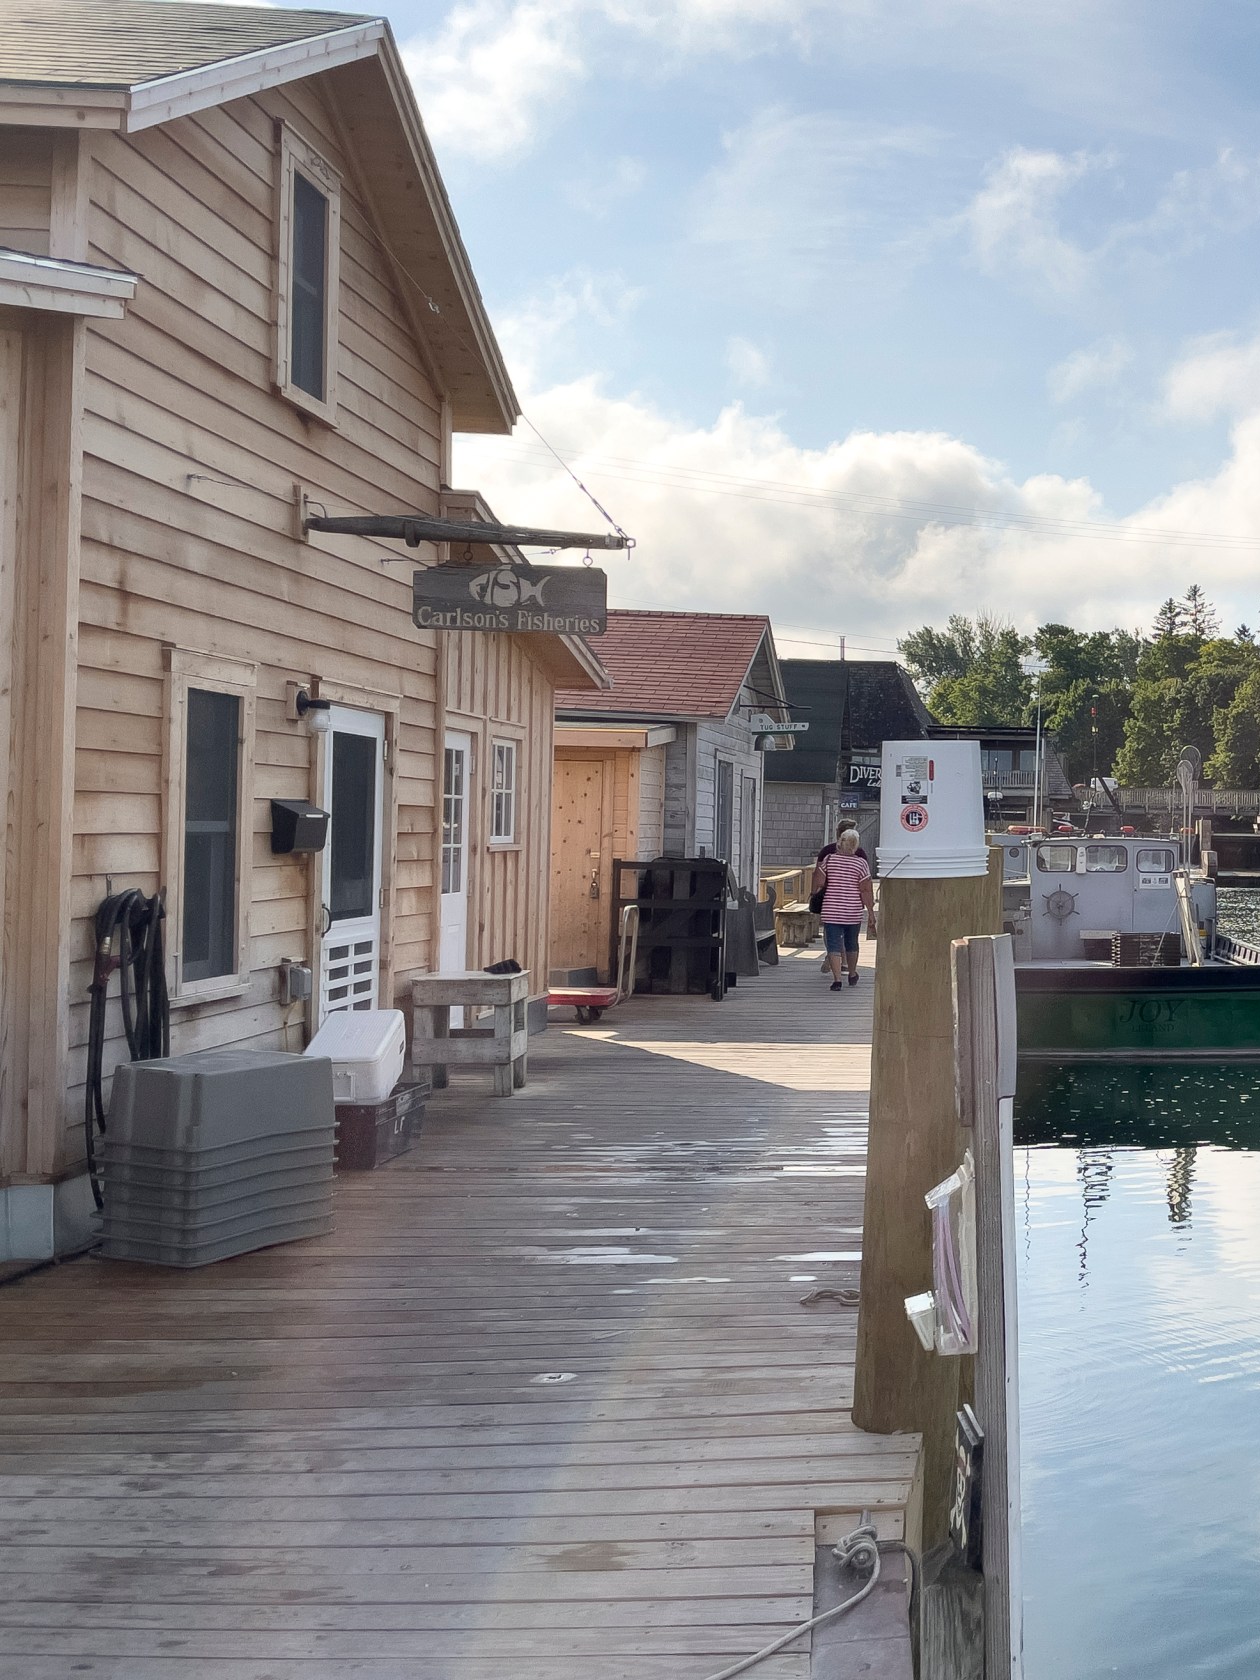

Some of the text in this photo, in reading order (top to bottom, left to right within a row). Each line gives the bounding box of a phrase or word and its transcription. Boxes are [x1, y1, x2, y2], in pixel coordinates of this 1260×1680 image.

[417, 606, 600, 633] Carlson's Fisheries
[1119, 999, 1186, 1023] JOY
